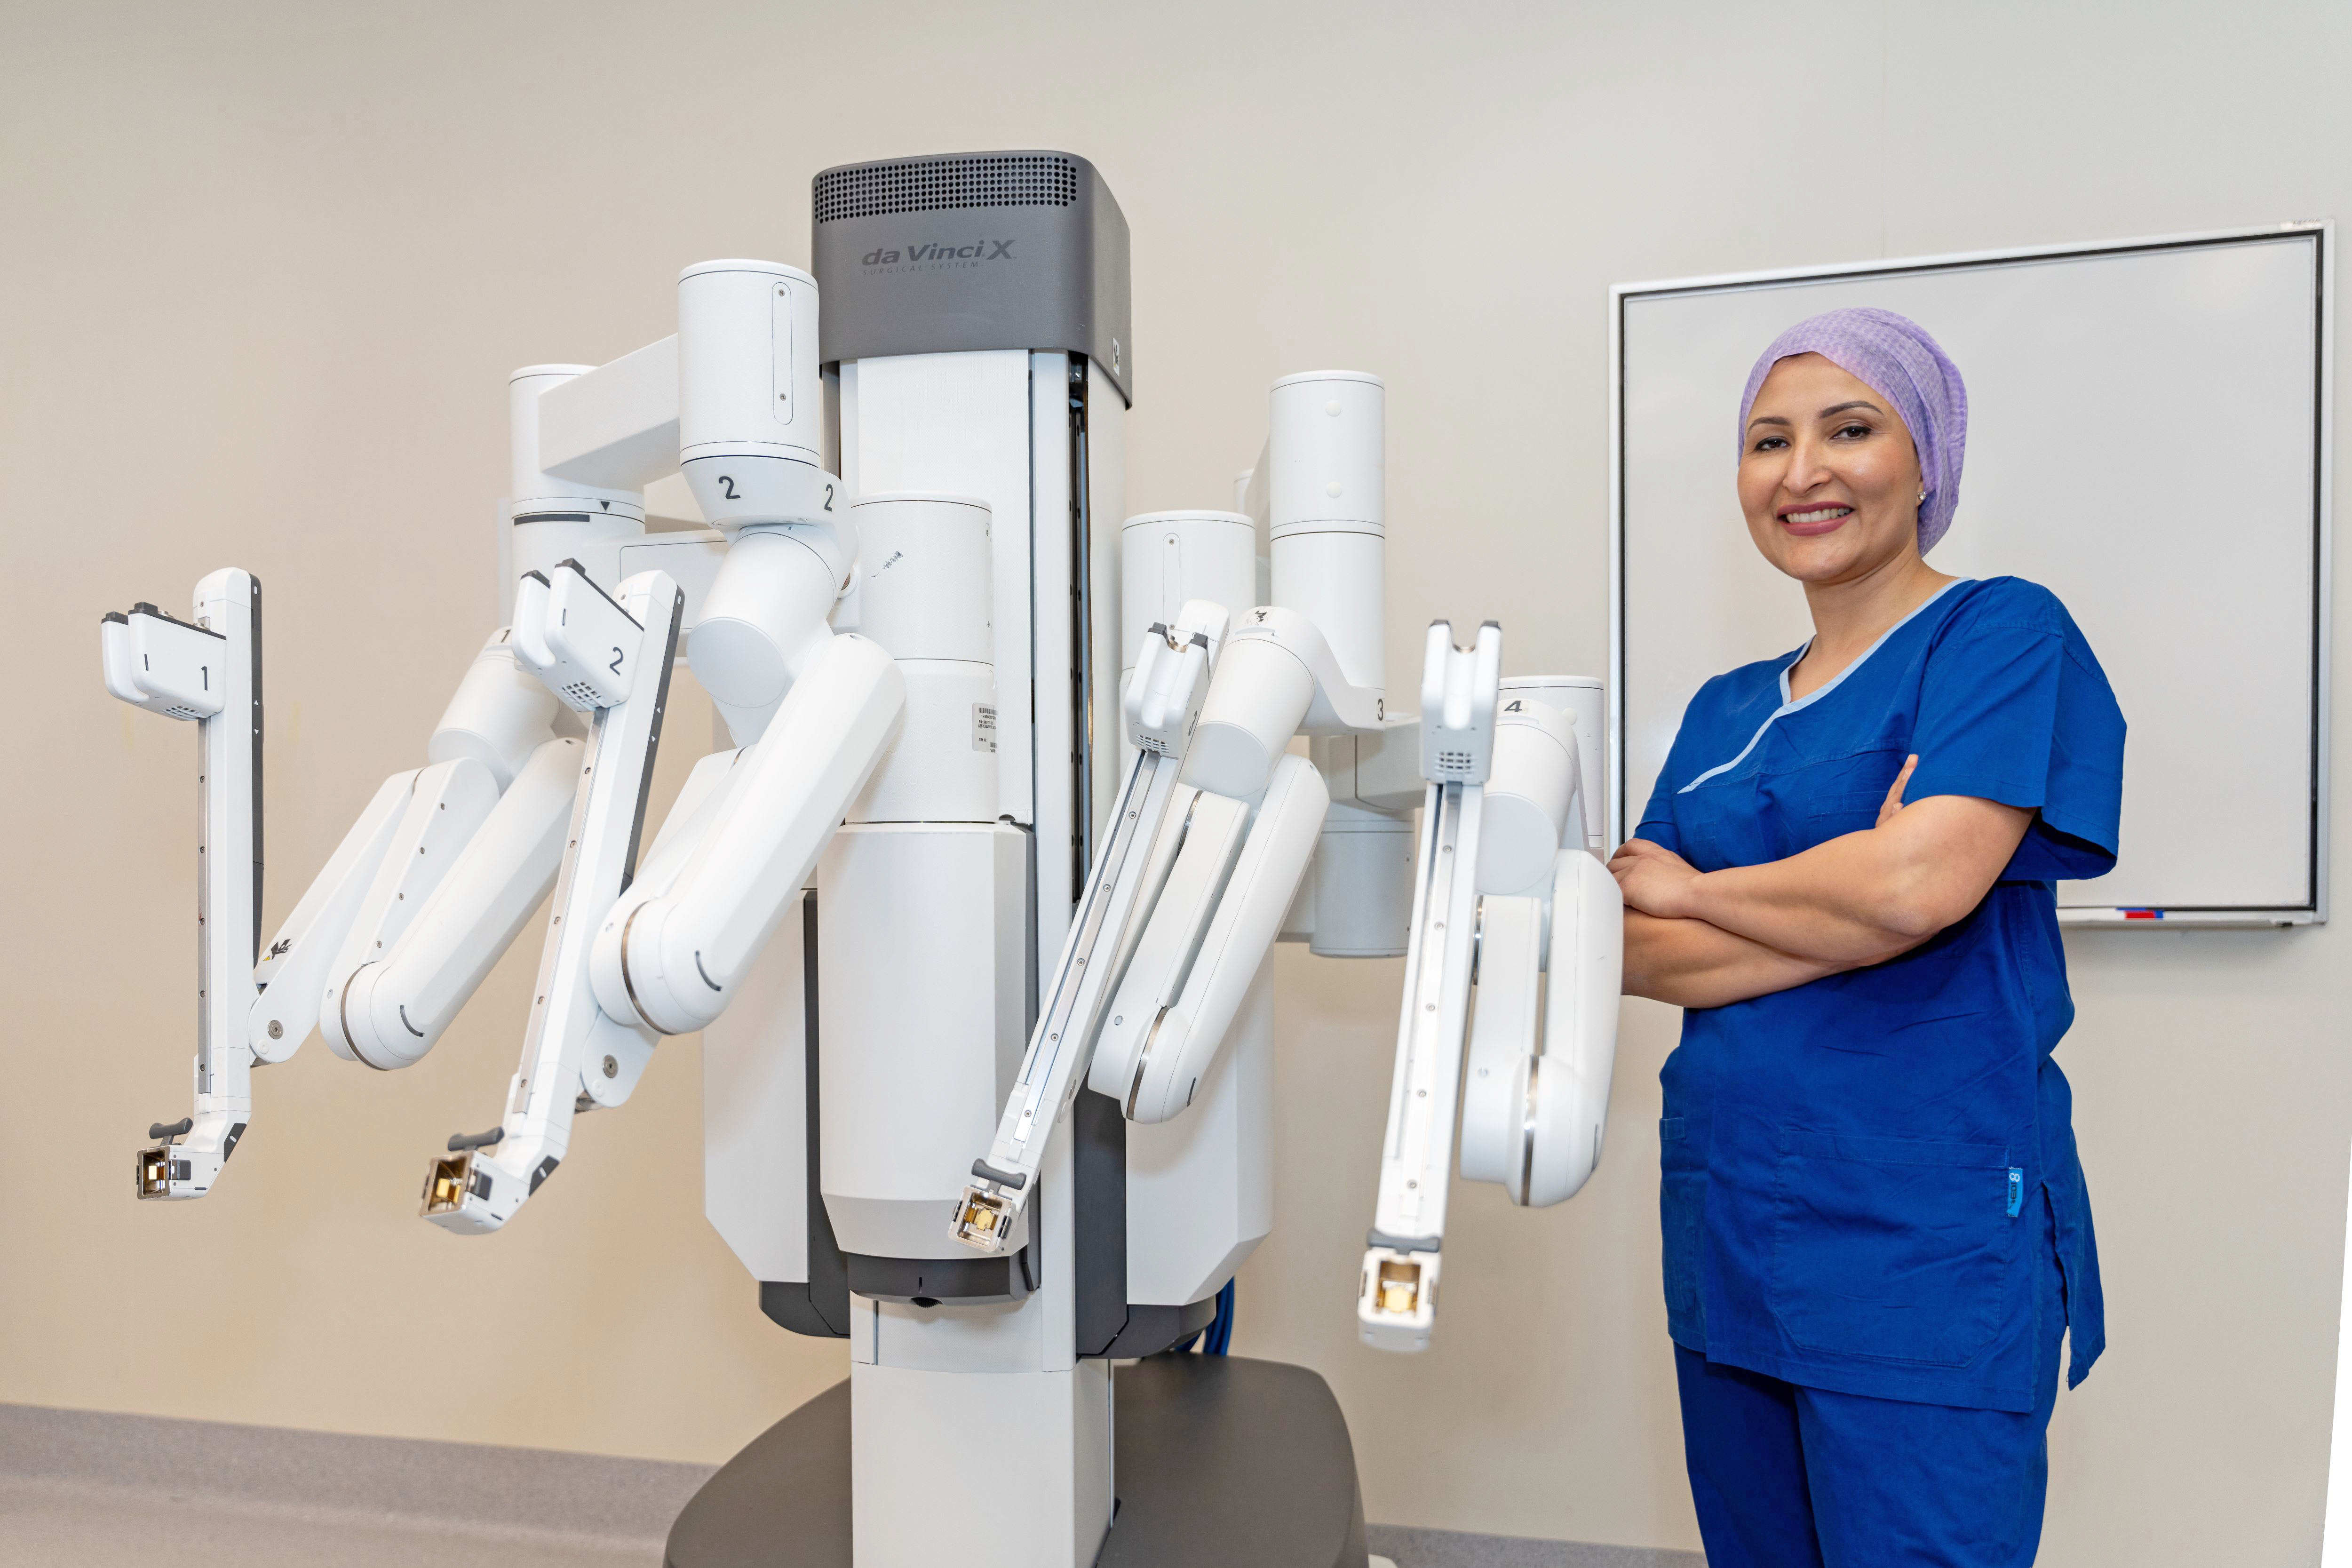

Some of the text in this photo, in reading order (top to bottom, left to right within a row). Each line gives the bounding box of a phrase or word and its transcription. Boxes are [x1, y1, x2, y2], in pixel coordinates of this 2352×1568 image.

[862, 248, 900, 266] da
[986, 240, 1016, 260] X
[863, 262, 978, 276] SURGICAL SYSTEM
[718, 476, 741, 500] 2
[824, 484, 834, 512] 2
[501, 629, 511, 643] 1
[609, 646, 624, 676] 2
[201, 666, 208, 691] 1
[1377, 698, 1383, 721] 3
[1504, 700, 1522, 713] 4
[1188, 710, 1198, 737] 3
